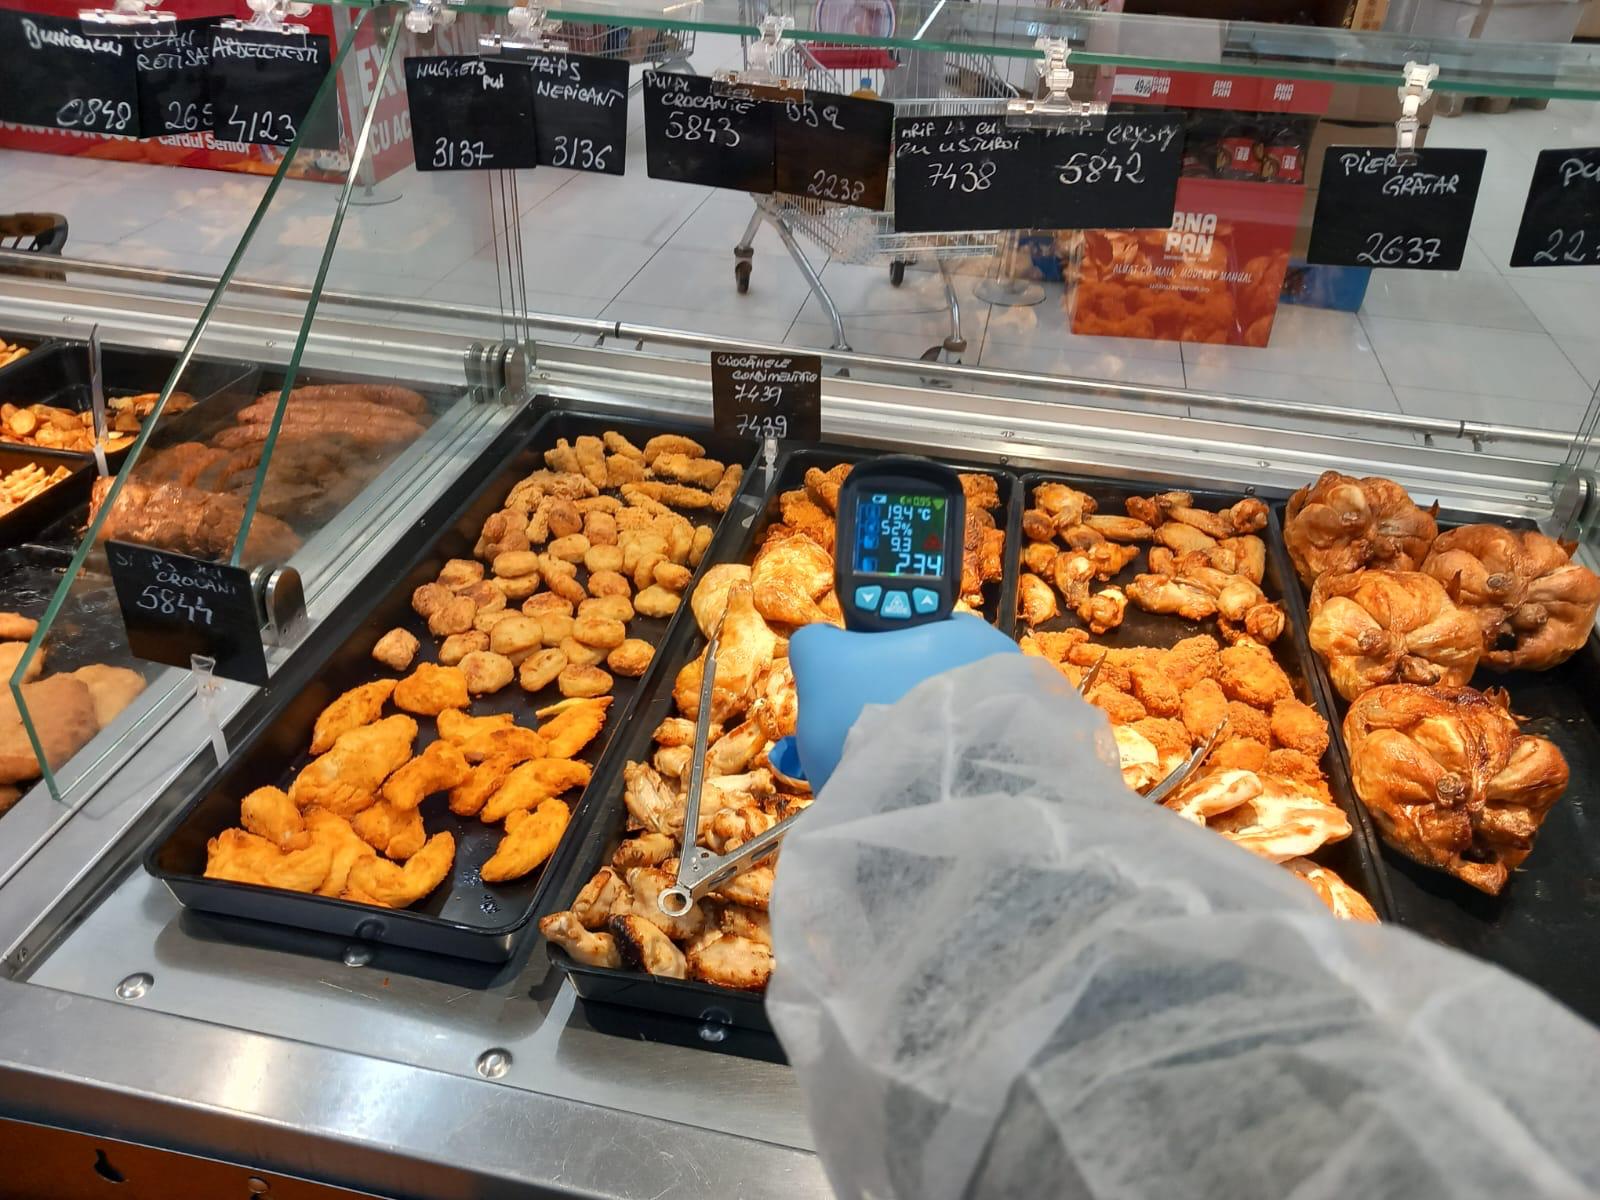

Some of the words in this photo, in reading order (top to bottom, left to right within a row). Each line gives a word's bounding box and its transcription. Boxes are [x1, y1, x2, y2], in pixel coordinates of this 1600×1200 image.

[207, 135, 251, 154] Senior
[665, 111, 741, 148] 5843
[432, 136, 495, 170] 3137
[552, 136, 614, 170] 3136
[1055, 149, 1146, 186] 5842
[807, 168, 866, 203] 2238
[927, 160, 997, 194] 7438
[1169, 211, 1218, 234] ANA
[1164, 231, 1214, 257] PAN
[1355, 231, 1442, 265] 2637
[734, 382, 783, 408] 7439
[881, 519, 914, 537] 52%
[136, 584, 214, 625] 5844
